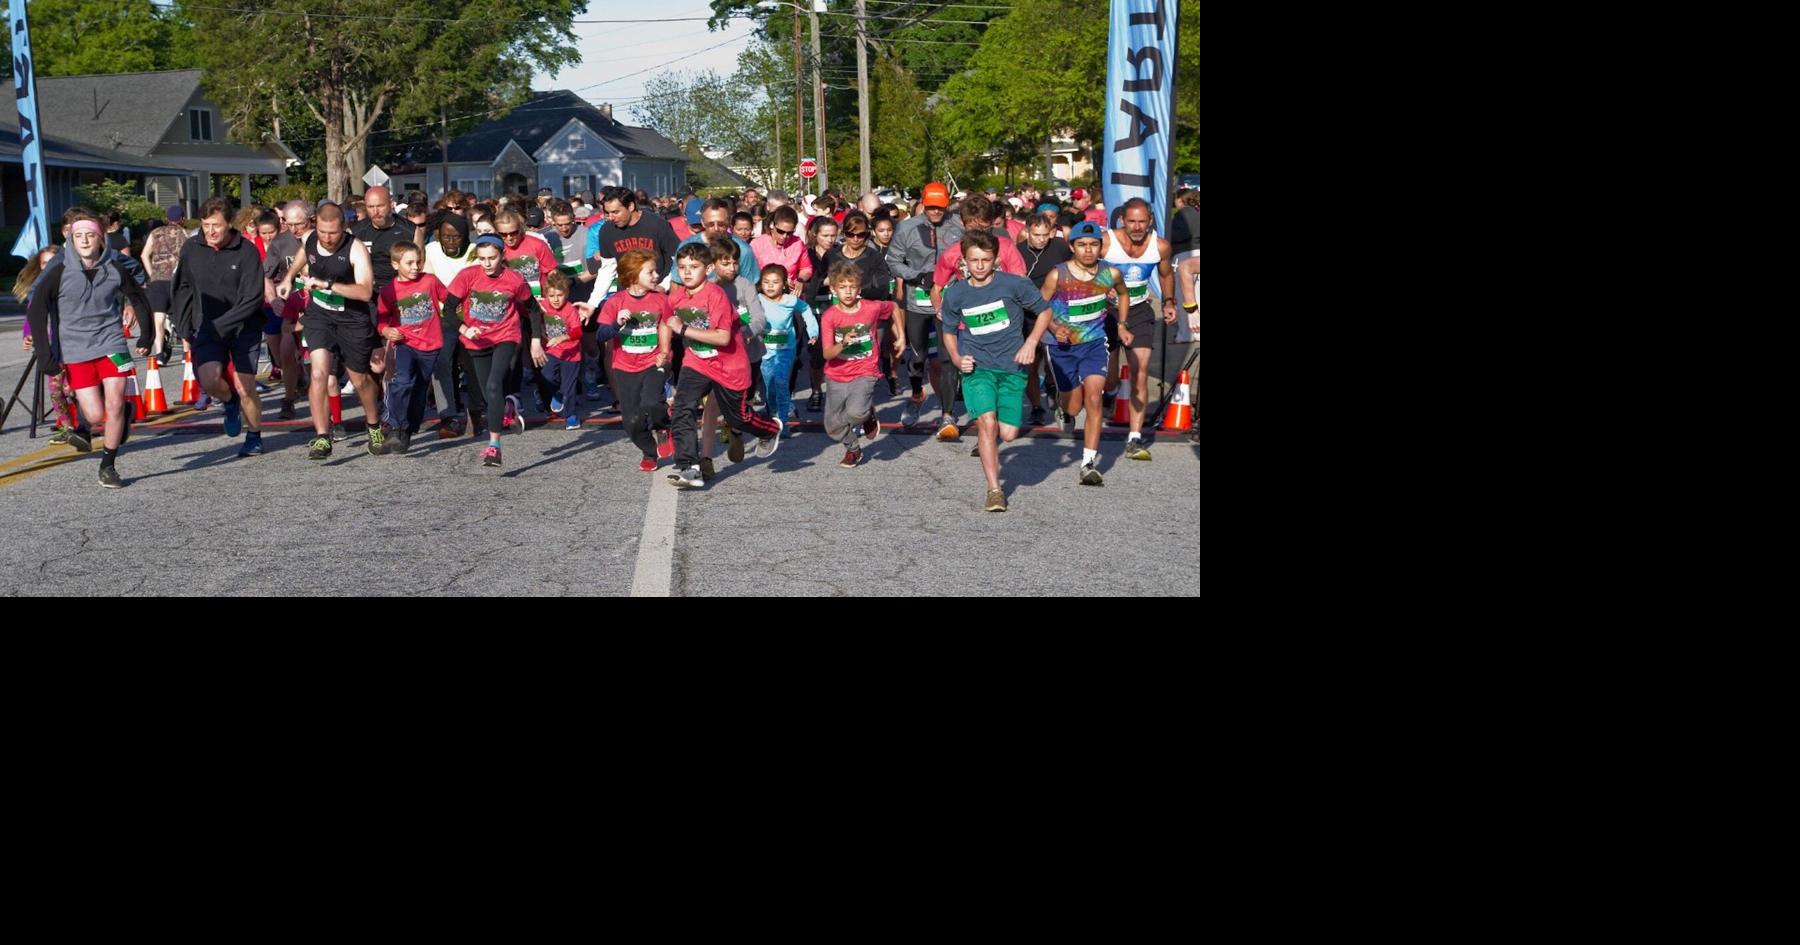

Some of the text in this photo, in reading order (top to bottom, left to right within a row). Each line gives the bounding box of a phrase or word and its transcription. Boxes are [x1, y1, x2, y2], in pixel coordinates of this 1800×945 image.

[800, 165, 817, 173] STOP
[614, 237, 655, 253] GEORGIA
[1080, 303, 1098, 313] 707
[975, 311, 996, 324] 723
[629, 335, 647, 344] 553
